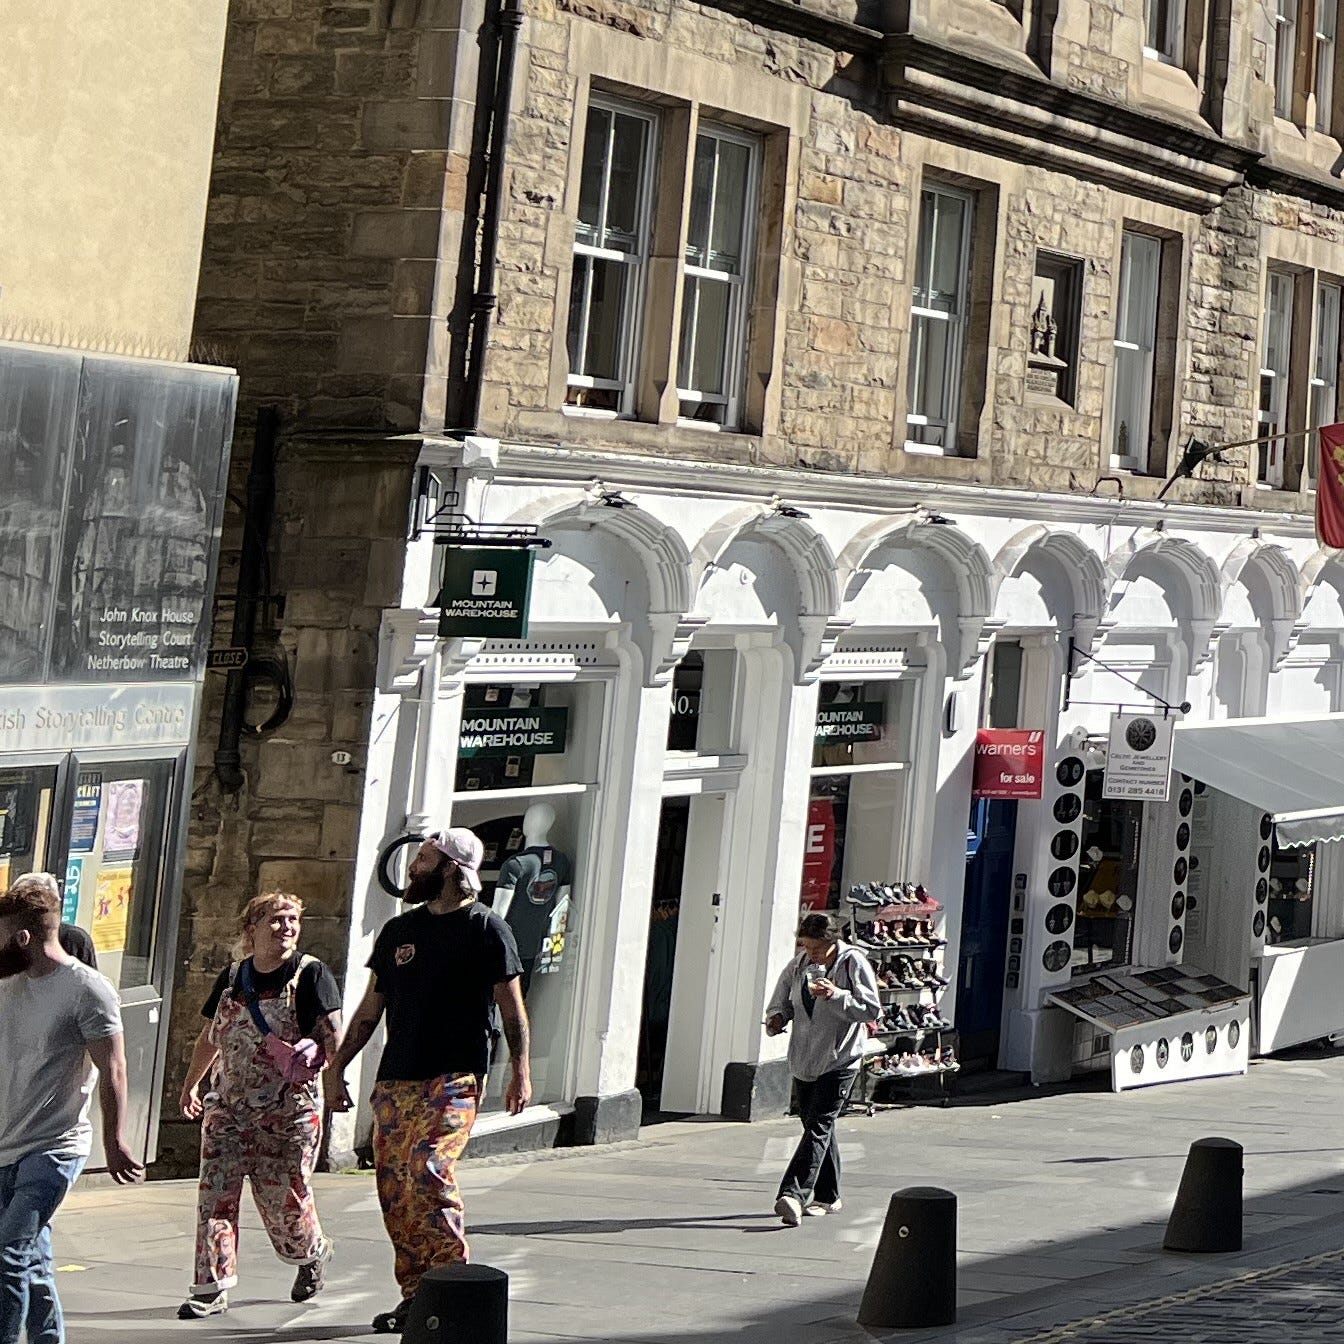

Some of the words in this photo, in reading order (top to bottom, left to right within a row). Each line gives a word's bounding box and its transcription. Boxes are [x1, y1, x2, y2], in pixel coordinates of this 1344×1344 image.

[451, 599, 513, 609] MOUNTAIN
[100, 607, 127, 623] John
[131, 607, 157, 623] Knox
[161, 608, 194, 623] House
[445, 608, 518, 618] WAREHOUSE
[98, 630, 158, 649] Storytelling
[162, 630, 192, 647] Court
[87, 654, 147, 671] Netherbow
[150, 654, 190, 670] Theatre
[212, 651, 242, 666] CLOSE
[35, 706, 126, 733] Storytelling
[134, 704, 185, 728] Centre
[817, 710, 864, 723] OUNTAIN
[461, 717, 540, 732] MOUNTAIN
[460, 732, 554, 749] WAREHOUSE
[976, 743, 1037, 756] warners
[1000, 771, 1012, 783] for
[1014, 772, 1035, 784] sale
